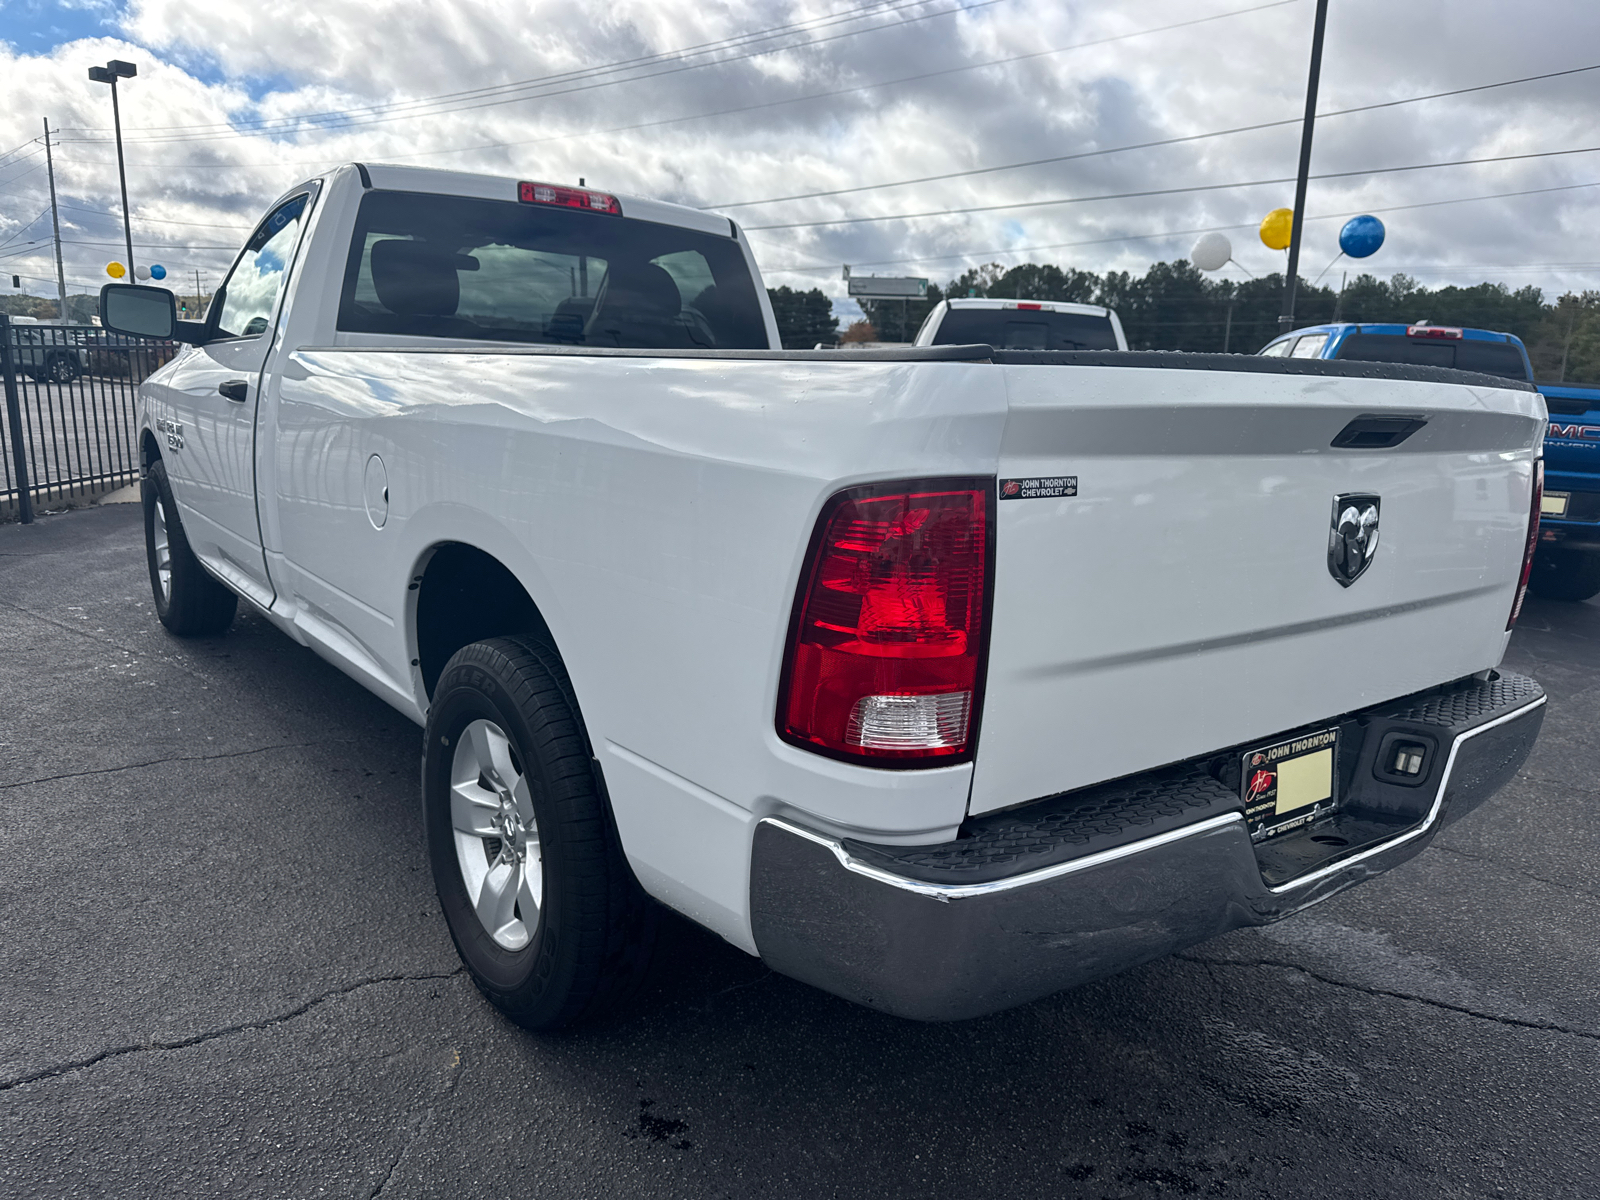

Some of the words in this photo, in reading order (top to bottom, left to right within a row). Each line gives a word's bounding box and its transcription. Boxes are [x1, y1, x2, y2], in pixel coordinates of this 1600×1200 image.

[1546, 423, 1600, 440] MC
[1022, 480, 1040, 489] JOHN
[1041, 478, 1076, 487] THORNTON
[1021, 487, 1063, 497] CHEVROLET
[1267, 744, 1291, 760] JOHN
[1291, 732, 1336, 753] THORNTON
[1277, 818, 1305, 833] CHEVROLET
